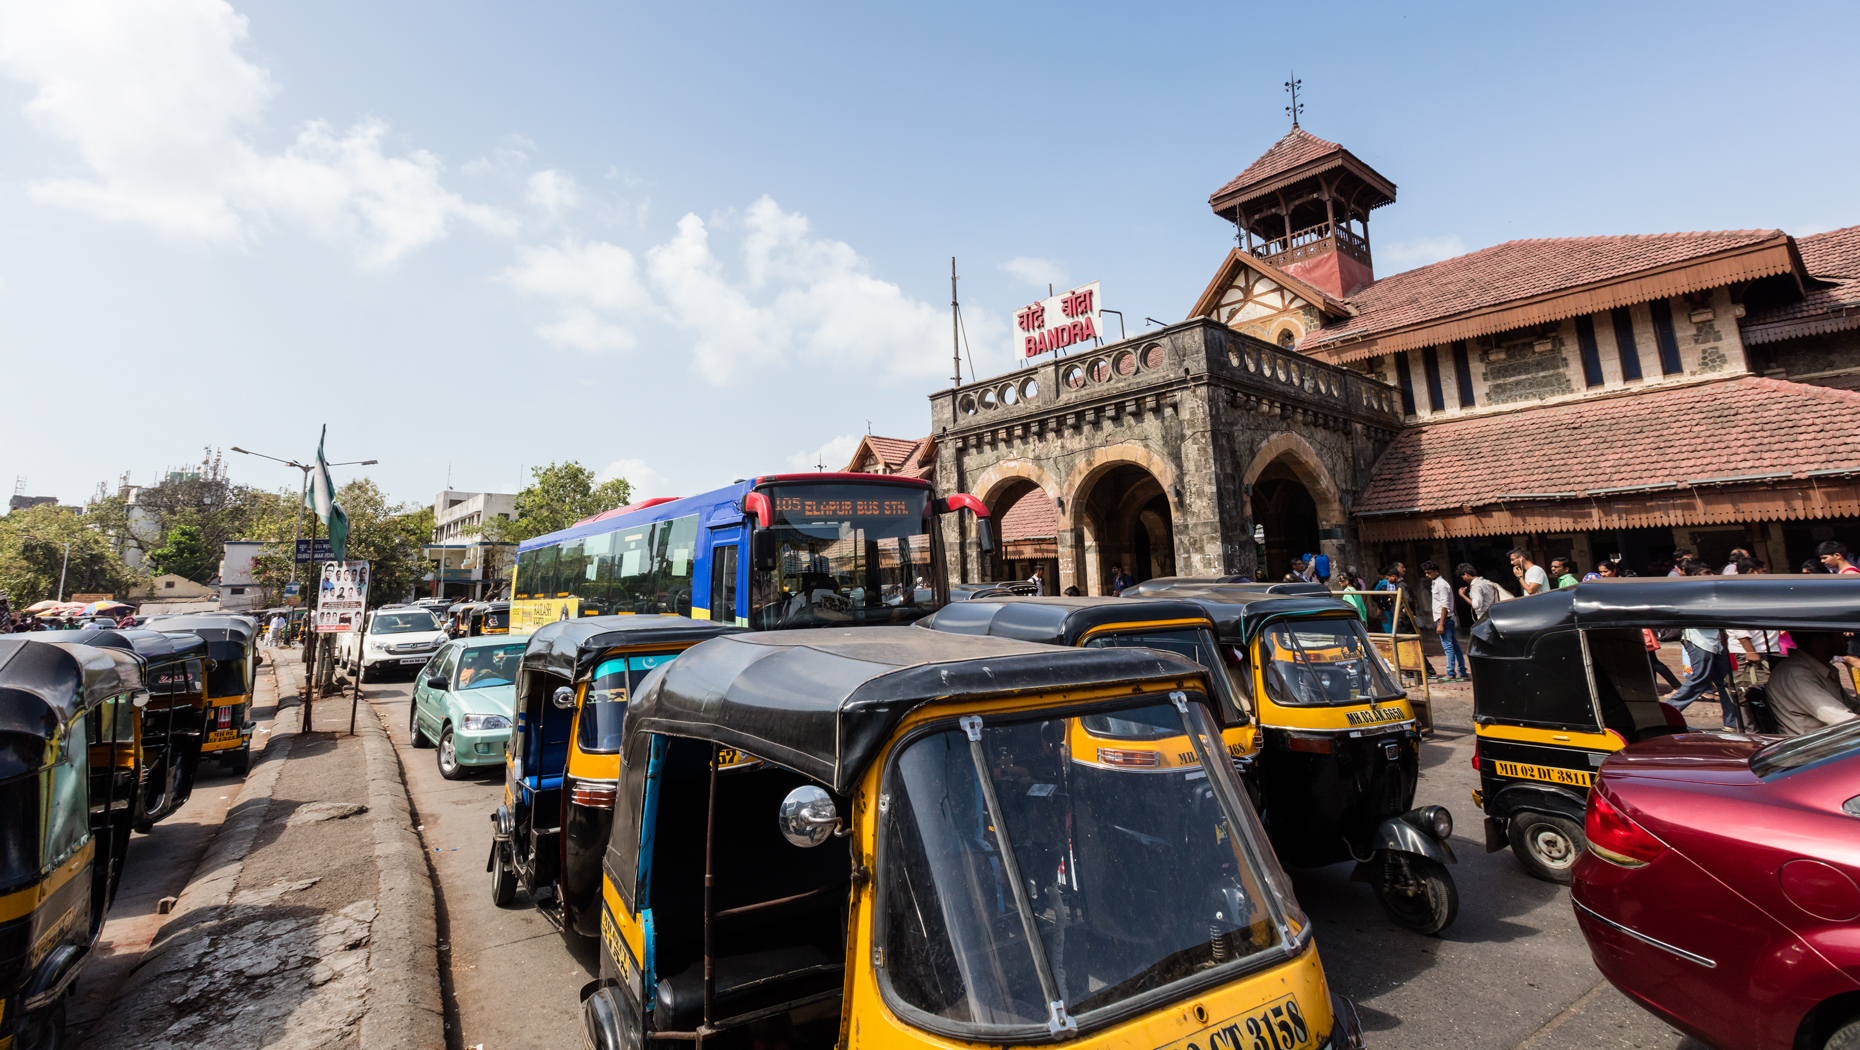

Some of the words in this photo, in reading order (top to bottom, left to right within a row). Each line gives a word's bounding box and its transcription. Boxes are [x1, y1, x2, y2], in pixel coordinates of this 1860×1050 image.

[1025, 316, 1096, 358] BANDRA
[775, 497, 801, 511] 105
[805, 501, 853, 516] ELAPUR
[857, 501, 880, 515] BUS
[533, 603, 552, 616] KAILASH
[1346, 707, 1405, 726] MH.03.AK.6650
[1499, 762, 1519, 776] MH
[1520, 765, 1535, 778] 02
[1537, 767, 1555, 781] DU
[1557, 769, 1588, 786] 3811
[1246, 1000, 1308, 1050] 3158
